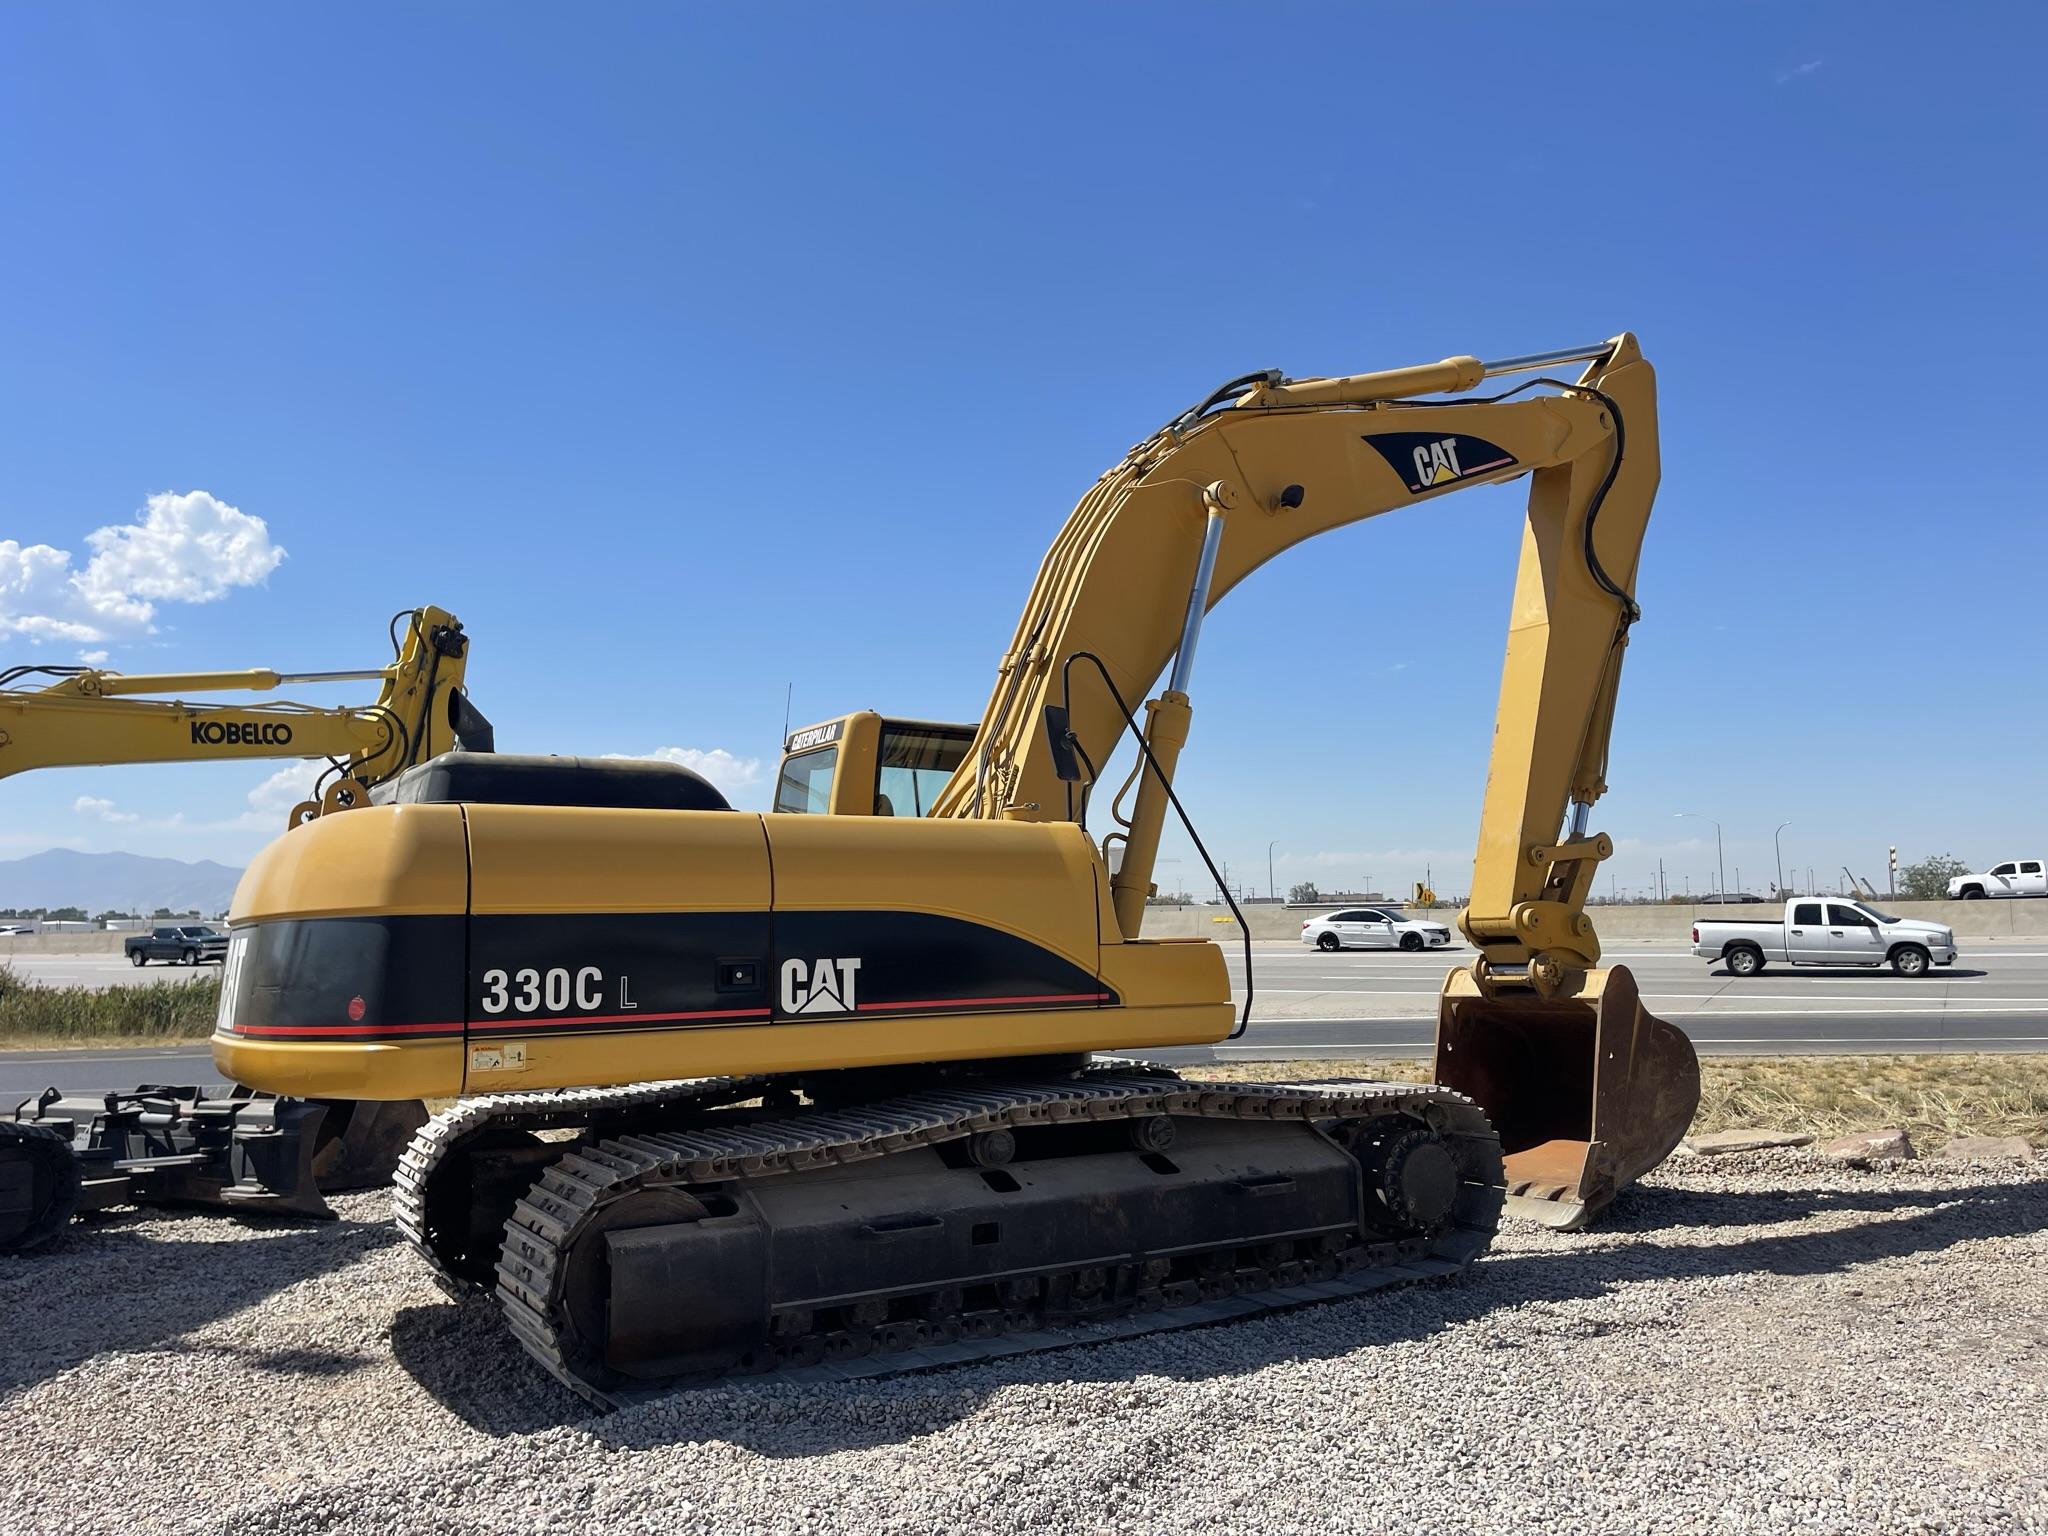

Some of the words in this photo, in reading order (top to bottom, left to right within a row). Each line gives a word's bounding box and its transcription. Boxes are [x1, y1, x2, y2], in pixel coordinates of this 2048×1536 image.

[1413, 438, 1462, 486] CAT
[191, 722, 292, 745] KOBELCO
[791, 724, 837, 750] CATERPILLAR
[482, 966, 603, 1014] 330C
[620, 976, 638, 1009] L
[781, 957, 862, 1014] CAT
